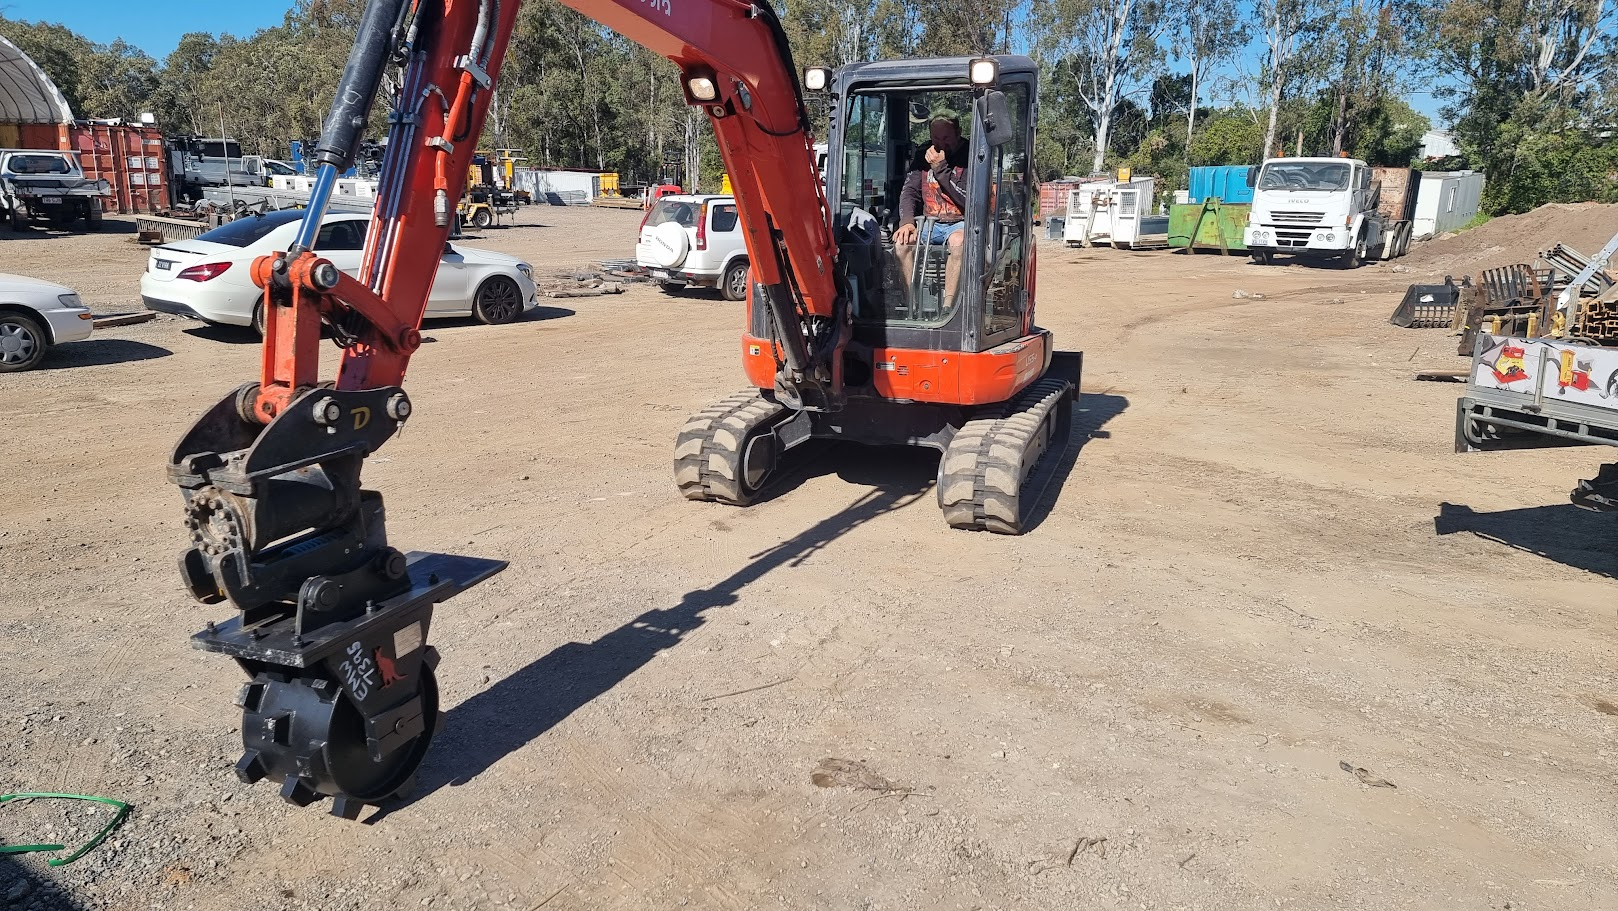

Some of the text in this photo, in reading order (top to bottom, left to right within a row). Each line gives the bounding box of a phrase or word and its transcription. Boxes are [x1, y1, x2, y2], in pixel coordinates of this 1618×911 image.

[655, 236, 674, 253] HONDA
[339, 661, 368, 702] EMW
[346, 641, 375, 686] 7395
